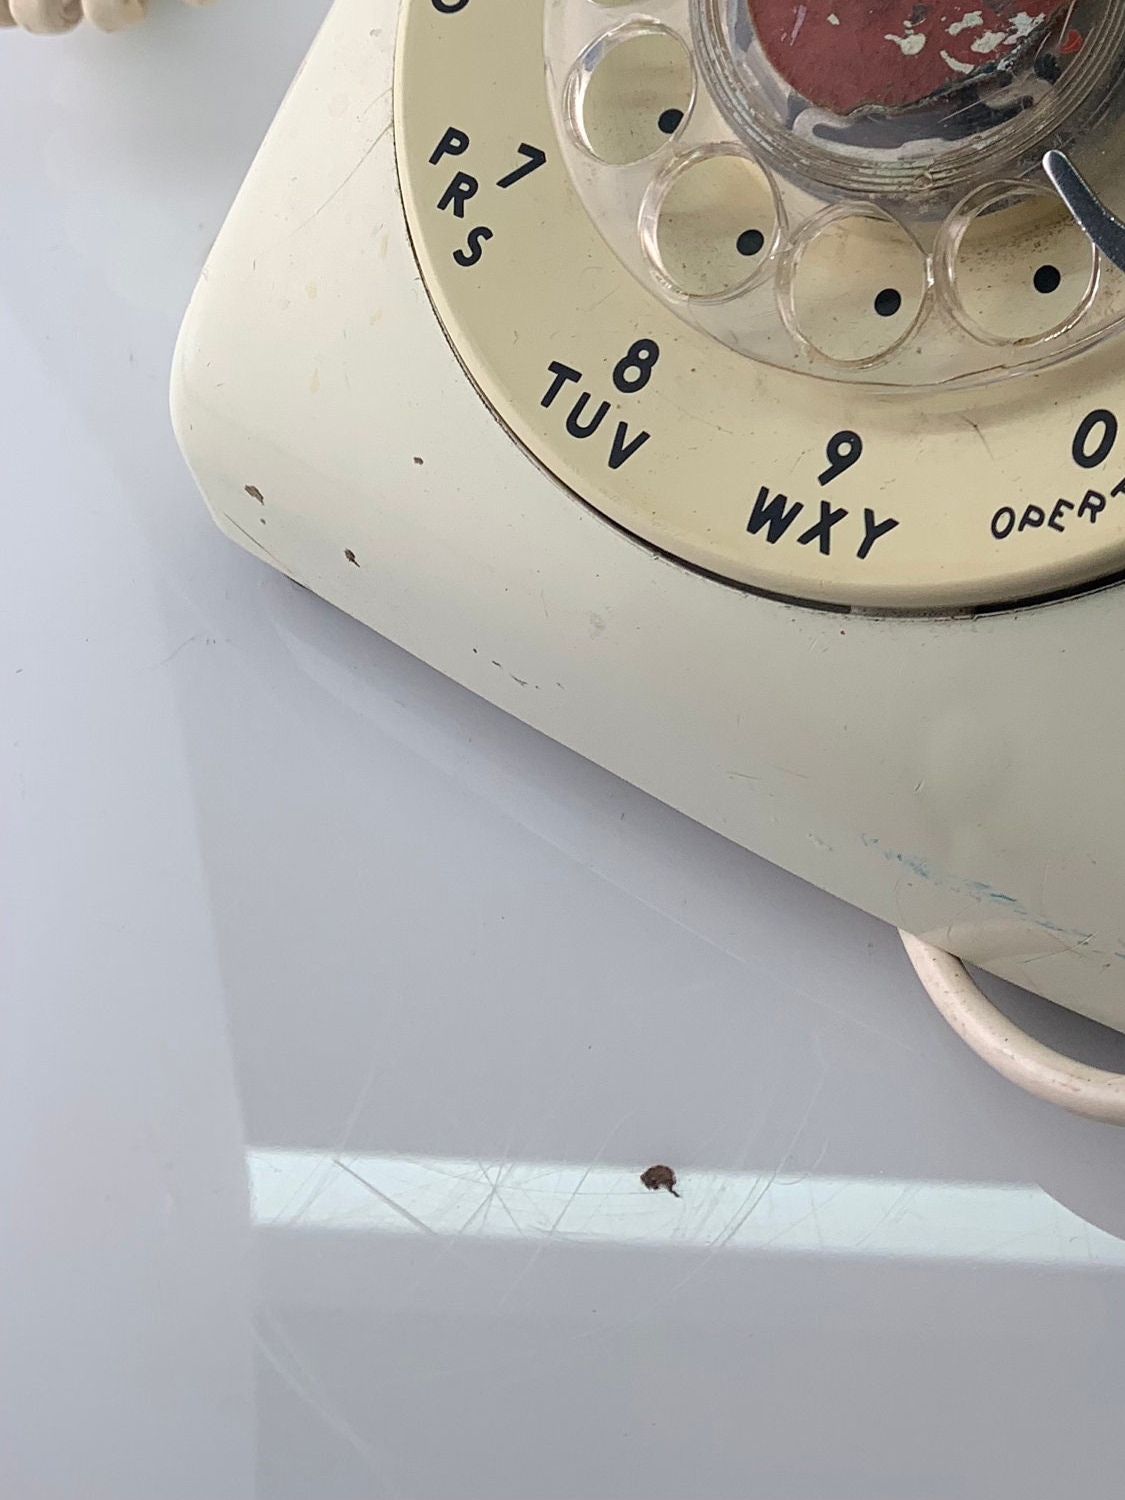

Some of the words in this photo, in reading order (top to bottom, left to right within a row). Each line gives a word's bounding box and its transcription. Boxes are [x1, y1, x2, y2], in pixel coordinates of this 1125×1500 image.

[428, 126, 494, 267] PRS
[495, 142, 547, 189] 7
[612, 338, 660, 394] 8
[540, 360, 651, 470] TUV
[817, 430, 863, 487] 9
[746, 485, 900, 560] WXY
